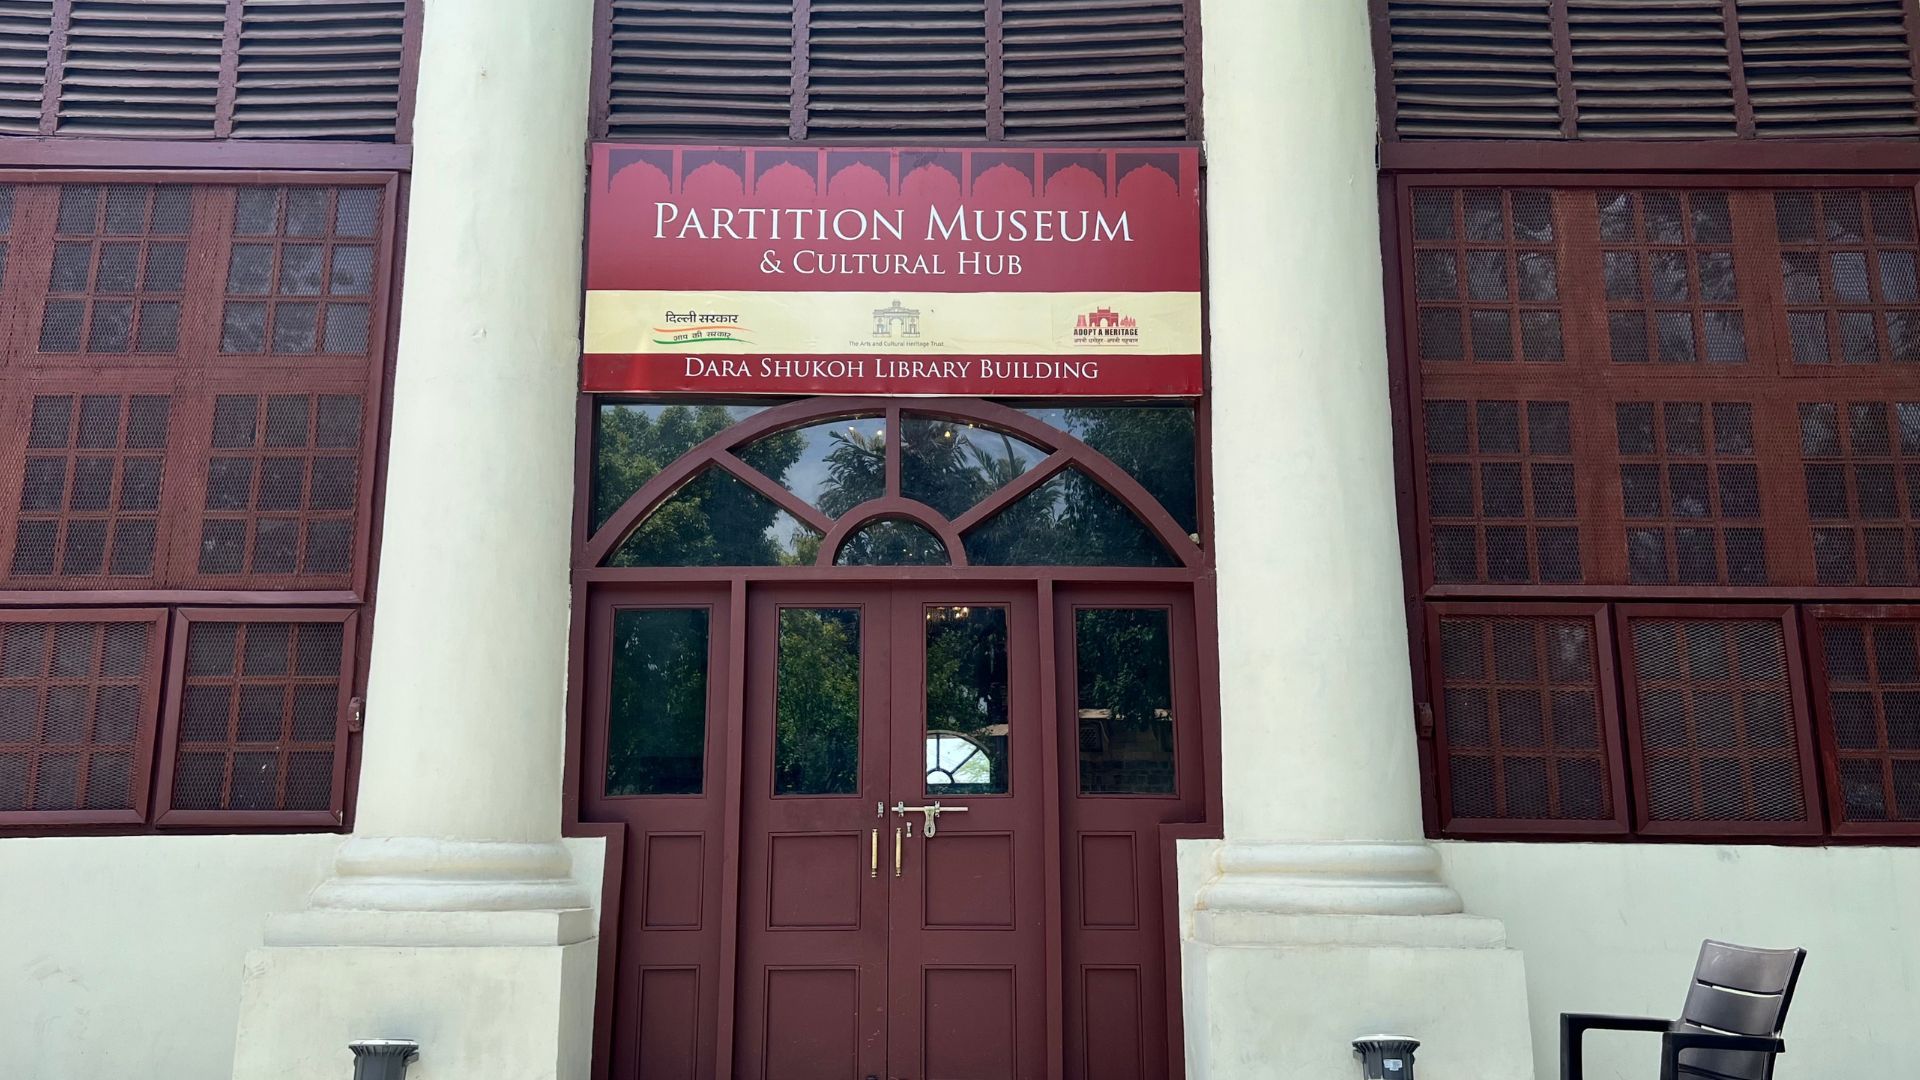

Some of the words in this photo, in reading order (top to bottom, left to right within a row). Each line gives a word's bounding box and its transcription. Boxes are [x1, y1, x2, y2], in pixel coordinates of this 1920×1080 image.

[653, 202, 905, 241] PARTITION
[924, 204, 1134, 242] MUSEUM
[760, 250, 785, 274] &
[793, 250, 946, 275] CULTURAL
[957, 251, 1023, 275] HUB
[665, 310, 697, 323] दिल्ली
[699, 314, 739, 323] सरकार
[692, 331, 702, 339] की
[707, 331, 731, 339] सरकार
[685, 357, 752, 377] DARA
[760, 358, 864, 378] SHUKOH
[875, 358, 971, 378] LIBRARY
[980, 359, 1099, 379] BUILDING
